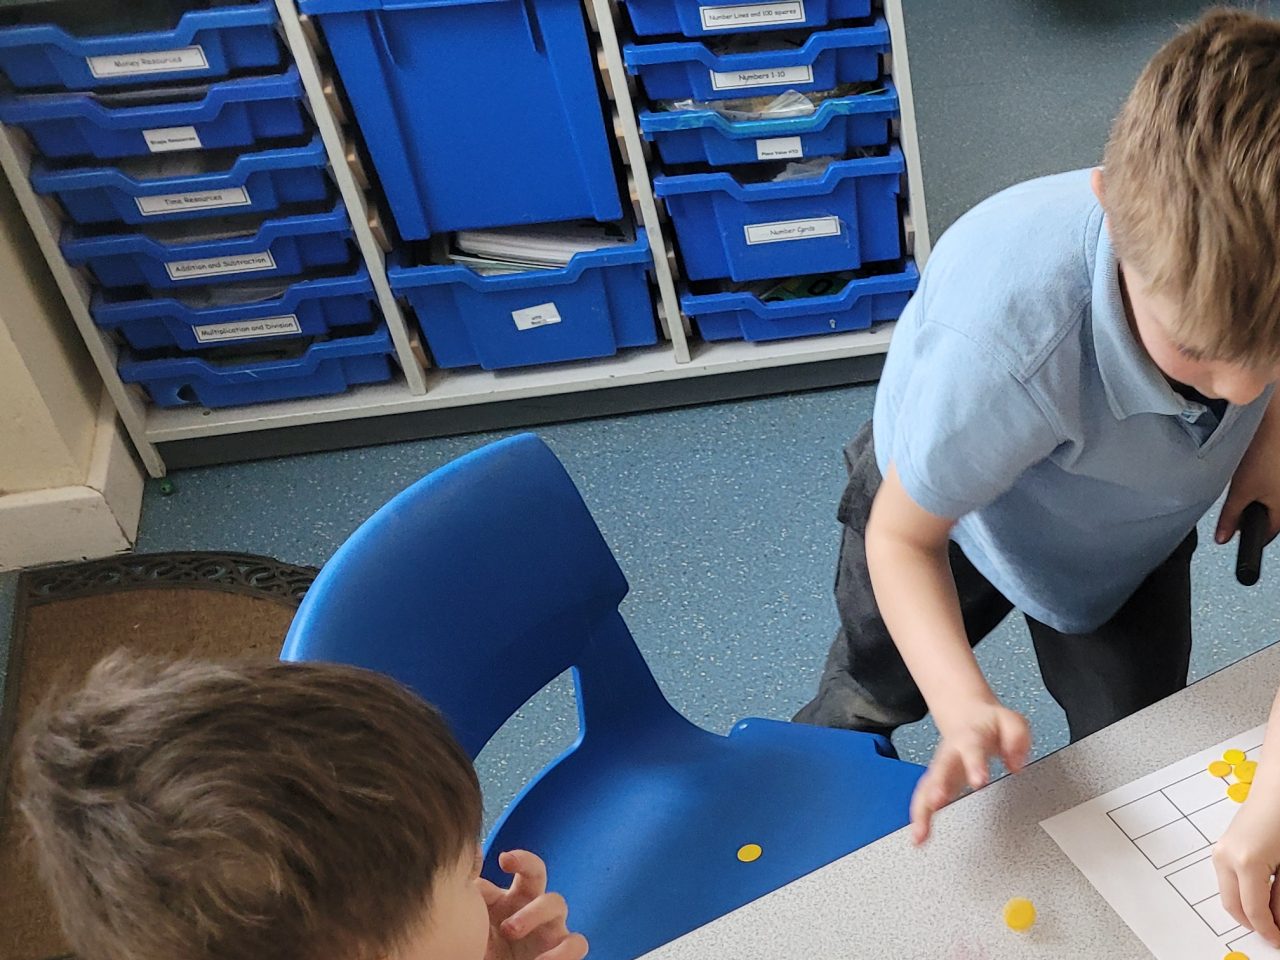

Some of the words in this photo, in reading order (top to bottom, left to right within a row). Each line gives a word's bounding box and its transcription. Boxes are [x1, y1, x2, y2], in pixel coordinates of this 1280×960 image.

[738, 72, 769, 81] Numbers
[175, 262, 207, 272] Addition
[208, 260, 222, 269] and
[223, 257, 266, 268] Subtraction
[201, 325, 250, 337] Multiplication
[251, 323, 264, 332] and
[265, 321, 294, 330] Division
